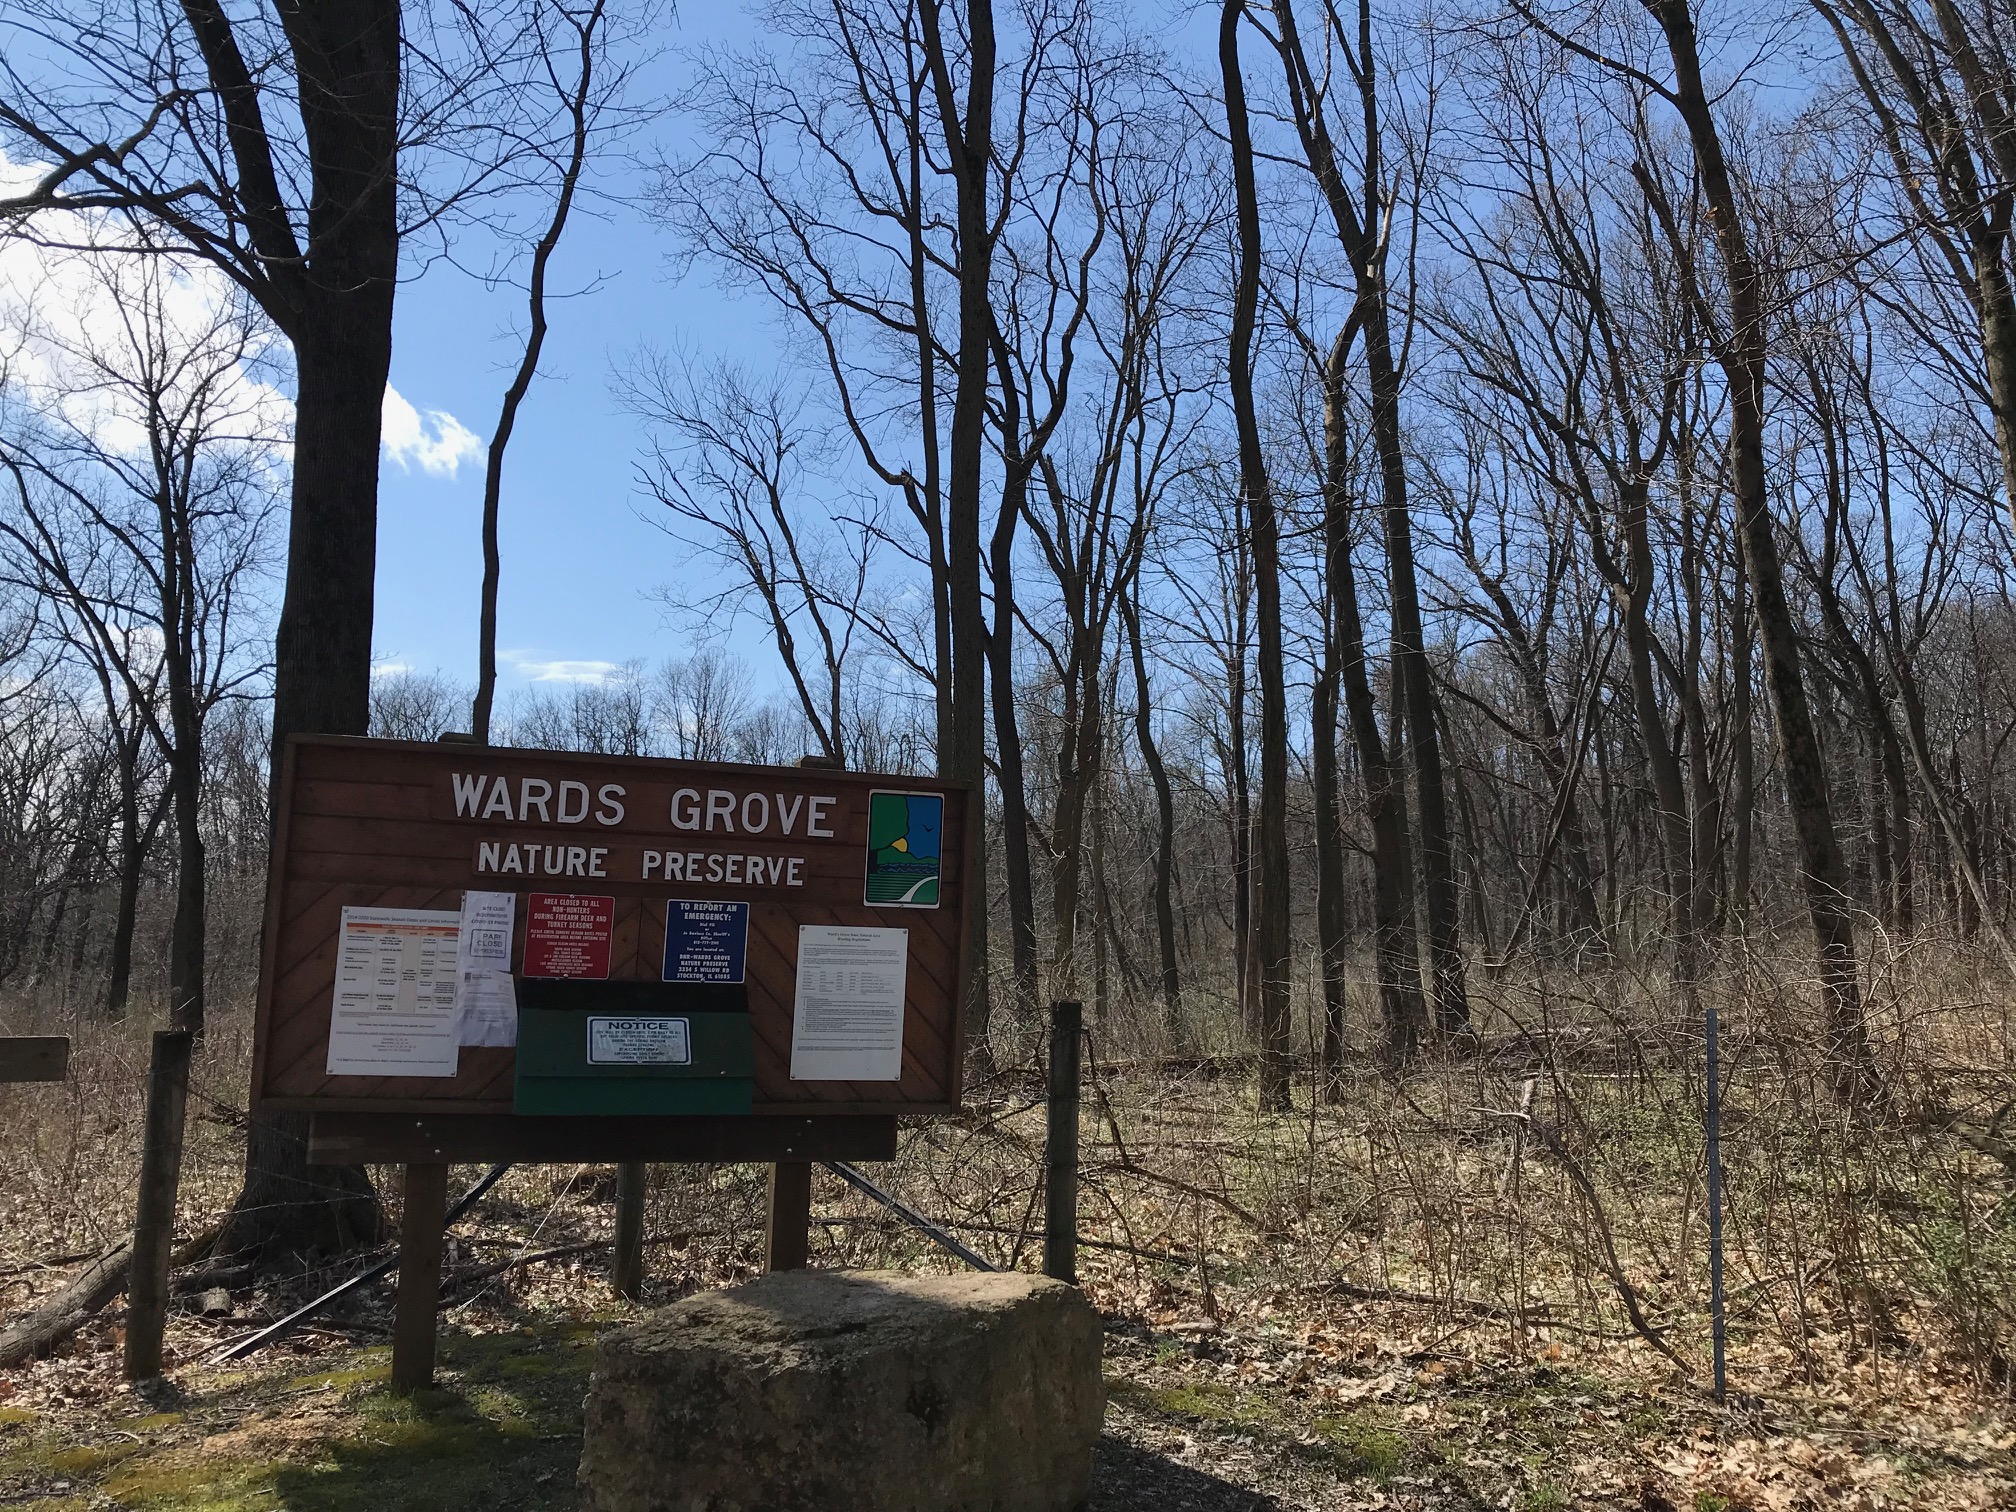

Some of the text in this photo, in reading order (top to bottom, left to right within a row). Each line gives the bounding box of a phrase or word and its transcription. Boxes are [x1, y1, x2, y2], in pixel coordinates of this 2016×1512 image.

[452, 774, 836, 838] WARDS GROVE
[478, 842, 804, 886] NATURE PRESERVE
[684, 912, 731, 921] EMERGENCY:
